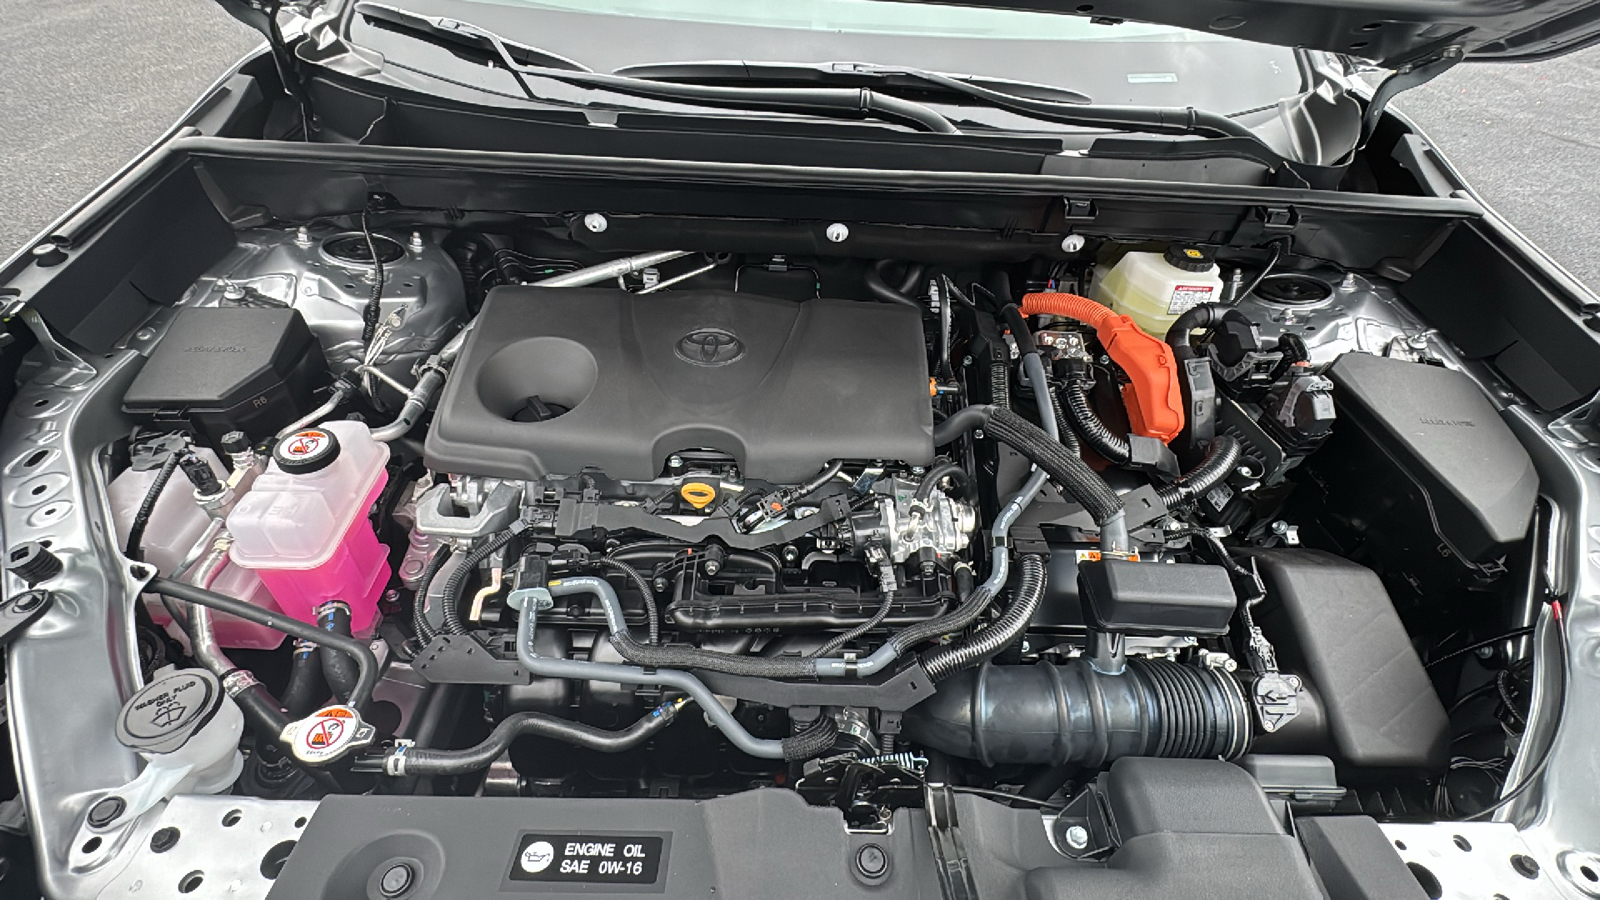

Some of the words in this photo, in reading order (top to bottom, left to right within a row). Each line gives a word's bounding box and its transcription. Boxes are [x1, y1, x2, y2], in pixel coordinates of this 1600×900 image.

[252, 395, 268, 409] R6
[564, 842, 616, 857] ENGINE
[623, 843, 646, 858] OIL
[559, 859, 591, 874] SAE
[598, 860, 643, 876] 0W-16
